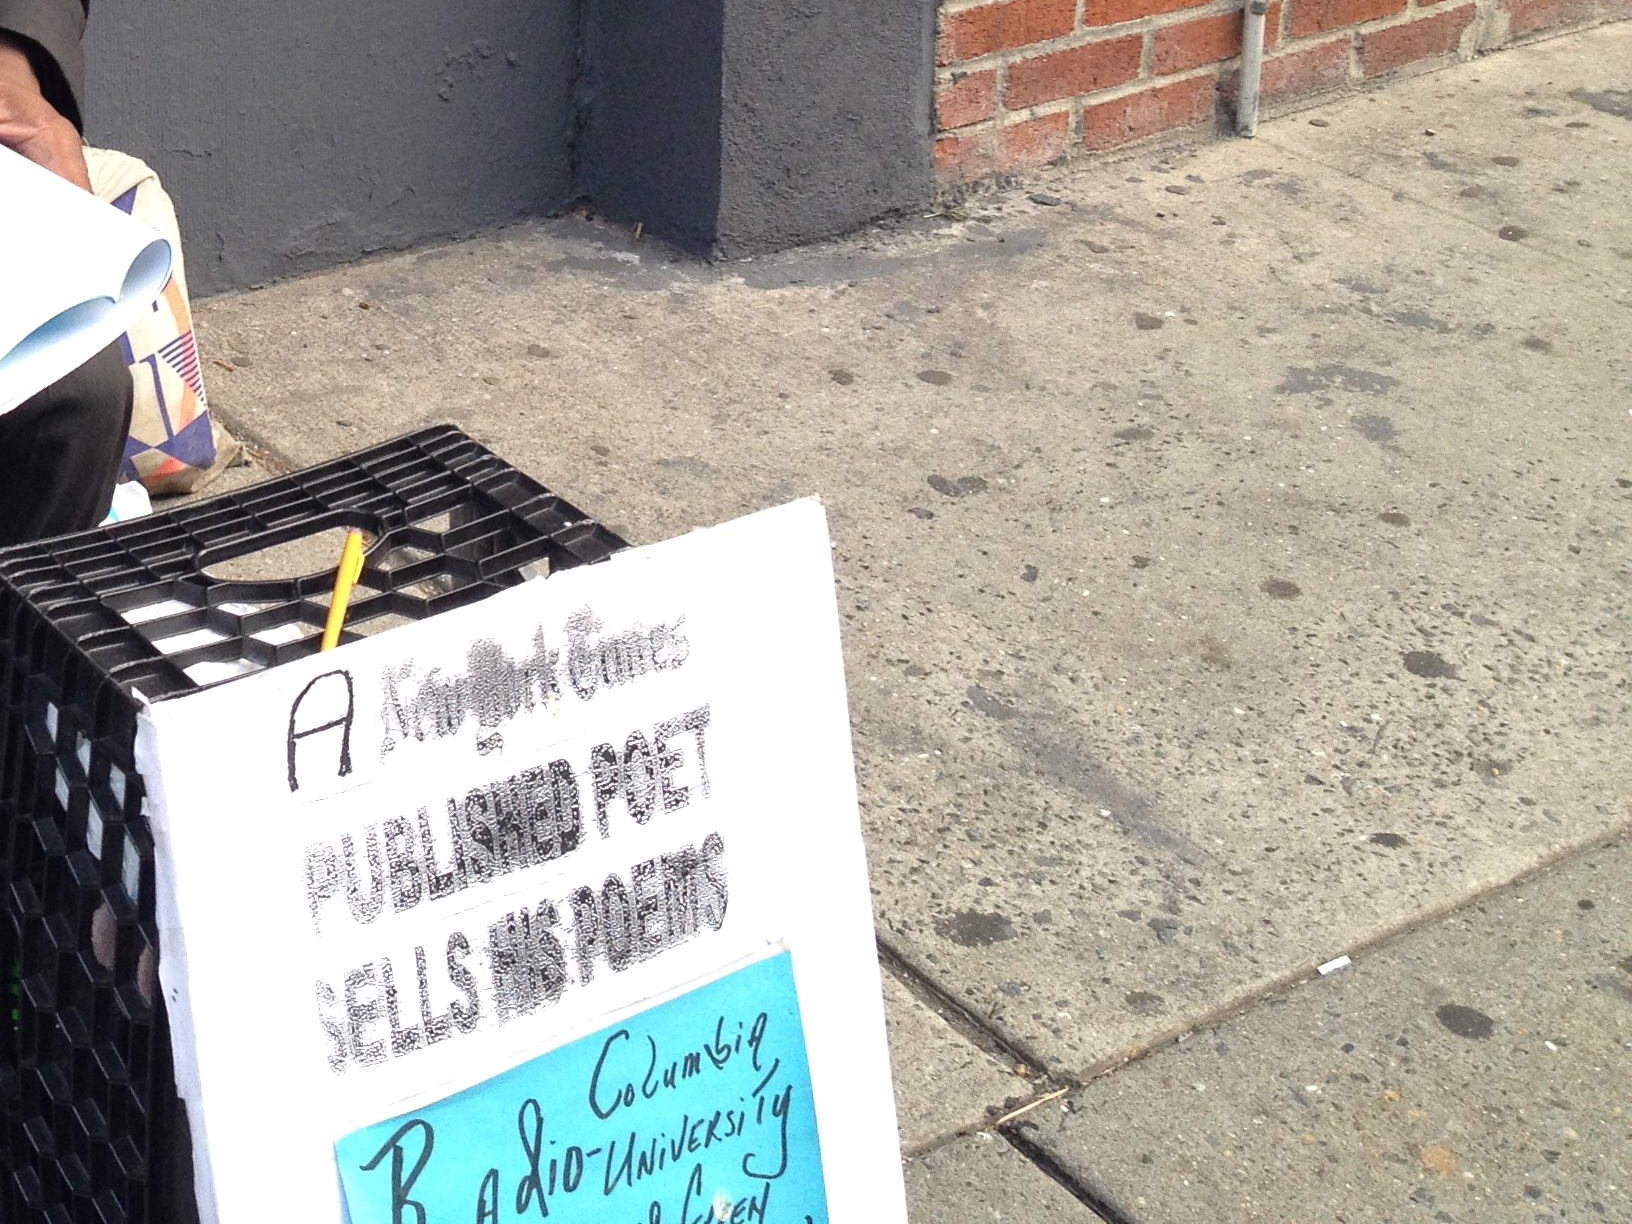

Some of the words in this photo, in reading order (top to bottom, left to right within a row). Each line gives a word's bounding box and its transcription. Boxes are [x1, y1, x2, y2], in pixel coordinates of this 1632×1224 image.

[287, 669, 355, 792] A
[304, 759, 585, 938] PUBLISHED
[590, 704, 711, 840] POET
[315, 931, 480, 1076] SELLS
[570, 831, 728, 988] POEMS
